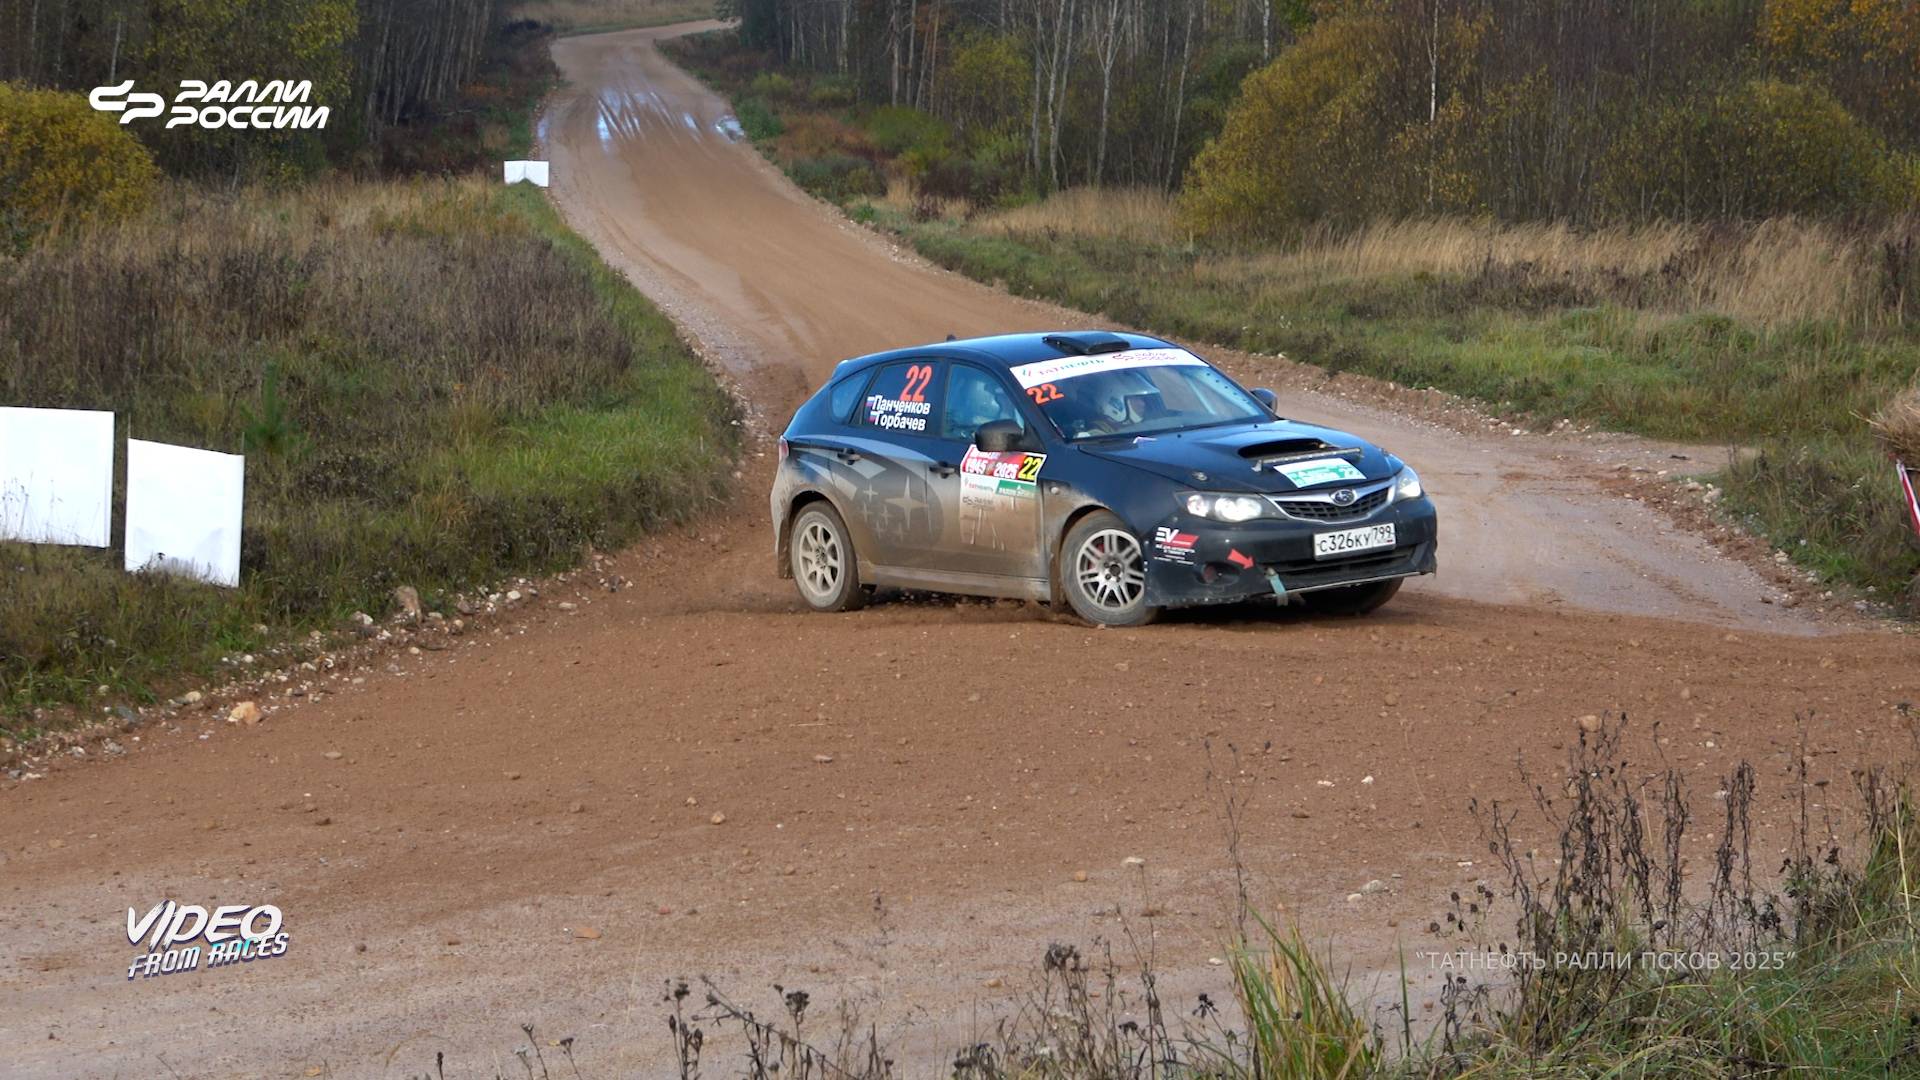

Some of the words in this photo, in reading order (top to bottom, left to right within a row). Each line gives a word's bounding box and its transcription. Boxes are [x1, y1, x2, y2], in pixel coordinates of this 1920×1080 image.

[899, 364, 932, 402] 22
[1026, 383, 1064, 405] 22
[872, 394, 931, 415] Панченков
[871, 410, 927, 431] Горбачев
[965, 457, 989, 475] 1945
[993, 462, 1020, 480] 2025
[1017, 456, 1042, 480] 22
